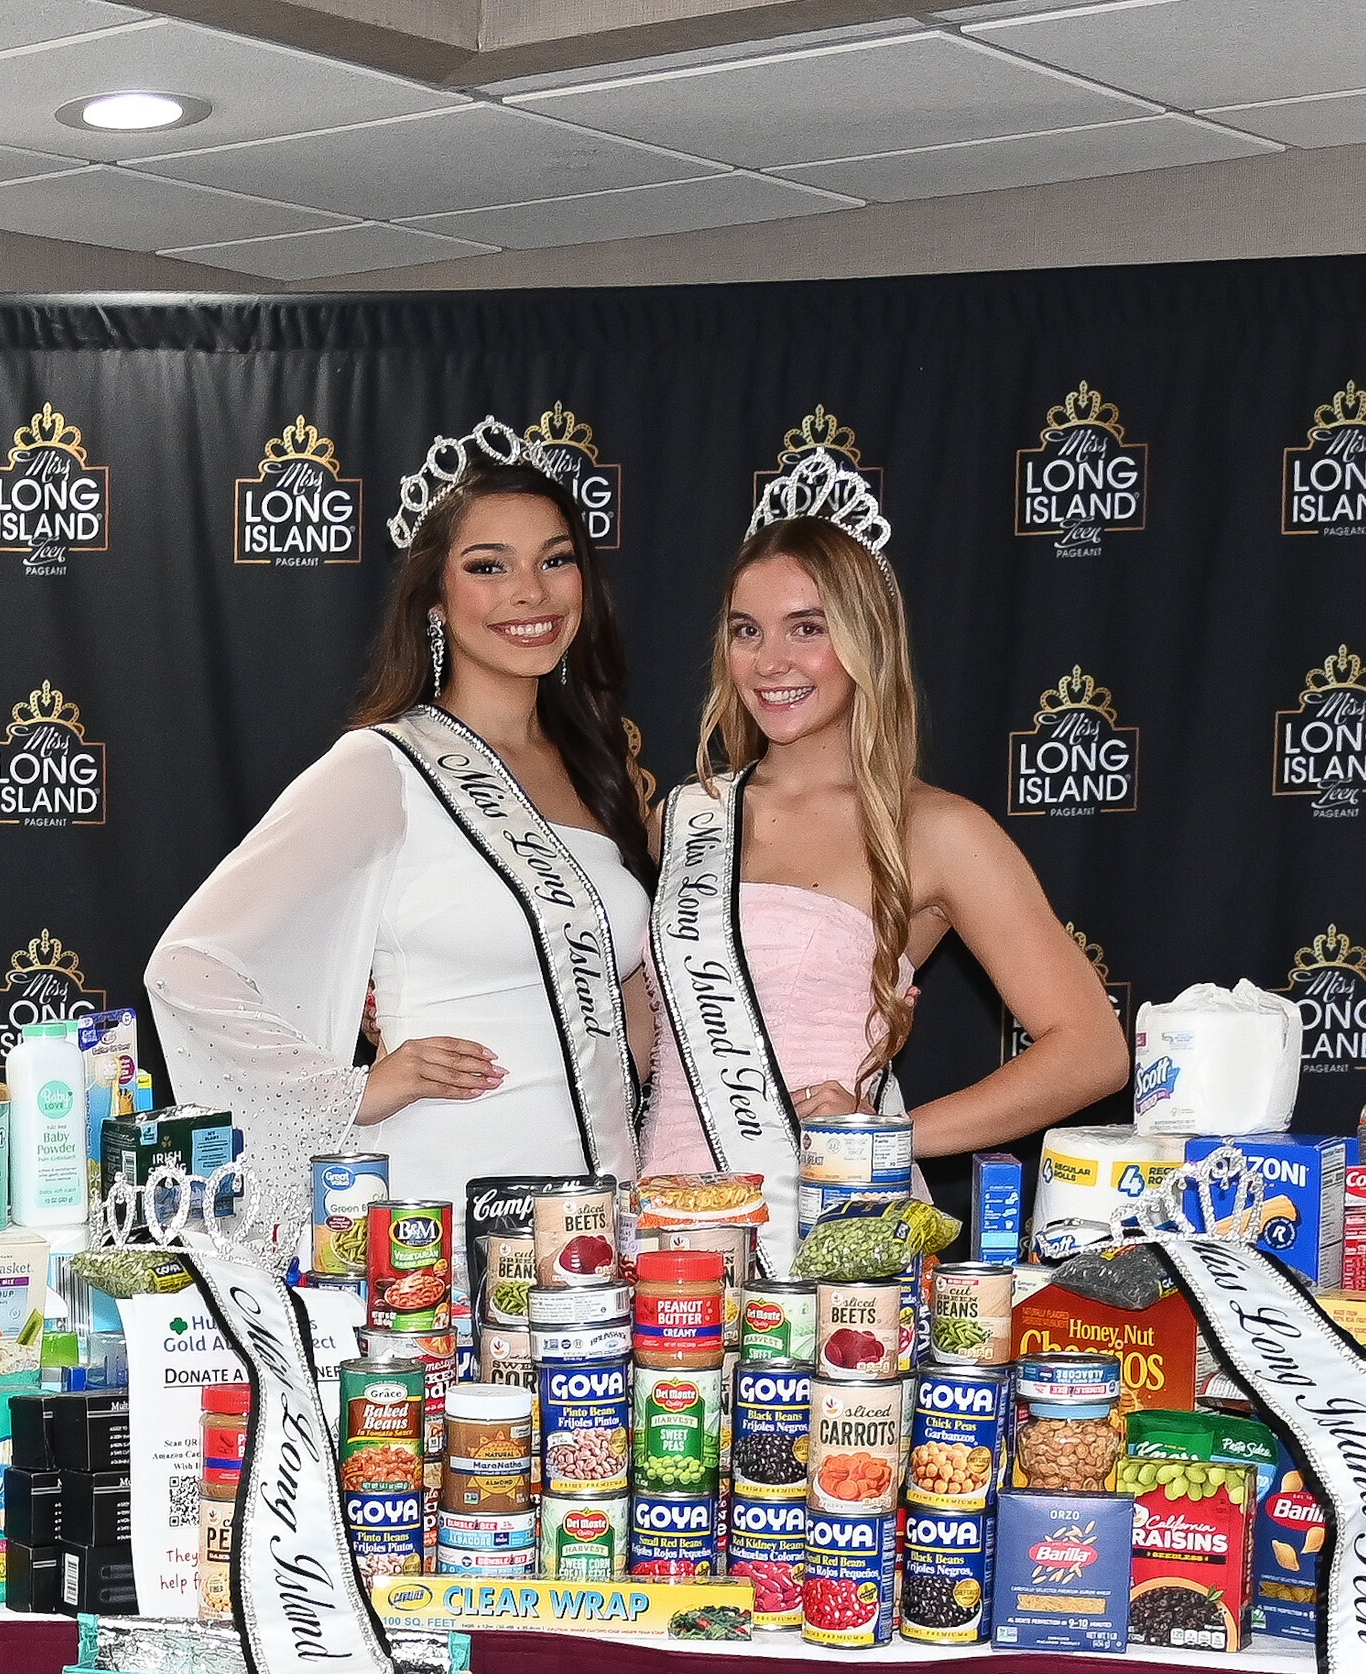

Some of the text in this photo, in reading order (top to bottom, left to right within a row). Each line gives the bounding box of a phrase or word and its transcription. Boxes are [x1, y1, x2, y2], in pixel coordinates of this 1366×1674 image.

[1045, 430, 1108, 459] Miss
[12, 449, 70, 483] Miss
[263, 461, 324, 495] Miss
[1028, 458, 1137, 492] LONG
[245, 491, 352, 522] LONG
[1056, 548, 1102, 557] PAGEANT
[275, 557, 318, 566] PAGEANT
[25, 565, 67, 576] PAGEANT
[1304, 692, 1366, 723] Miss
[1038, 712, 1101, 743] Miss
[10, 725, 70, 757] Miss
[1021, 741, 1129, 773] LONG
[1050, 808, 1095, 817] PAGEANT
[1314, 808, 1359, 818] PAGEANT
[25, 817, 67, 827] PAGEANT
[437, 755, 610, 1039] Miss Long Island
[667, 812, 767, 1141] Miss Long Island Teen
[11, 972, 70, 1001] Miss
[1293, 971, 1355, 1000] Miss
[1303, 1063, 1349, 1073] PAGEANT
[43, 1132, 69, 1144] Baby
[38, 1144, 76, 1154] Powder
[398, 1221, 435, 1240] B&M
[565, 1214, 605, 1231] BEETS
[658, 1301, 703, 1313] PEANUT
[832, 1308, 876, 1323] BEETS
[937, 1302, 978, 1318] BEANS
[658, 1313, 702, 1324] BUTTER
[232, 1286, 295, 1390] Miss
[663, 1329, 697, 1337] CREAMY
[1069, 1320, 1154, 1346] Honey Nut
[164, 1336, 206, 1352] Gold
[1230, 1300, 1317, 1386] Long
[165, 1369, 243, 1384] DONATE A
[551, 1372, 623, 1399] GOYA
[741, 1378, 811, 1401] GOYA
[371, 1390, 402, 1399] Grace
[920, 1383, 993, 1411] GOYA
[364, 1404, 408, 1417] Baked
[563, 1406, 615, 1416] Pinto Beans
[748, 1410, 802, 1420] Black Beans
[845, 1405, 891, 1418] sliced
[364, 1417, 408, 1429] Beans
[558, 1416, 592, 1429] Frijoles
[654, 1417, 694, 1426] HARVEST
[660, 1430, 688, 1441] SWEET
[820, 1420, 895, 1446] CARROTS
[663, 1441, 684, 1451] PEAS
[261, 1392, 320, 1533] Long
[348, 1500, 418, 1519] GOYA
[637, 1504, 708, 1529] GOYA
[734, 1506, 804, 1530] GOYA
[1051, 1510, 1079, 1520] ORZO
[907, 1518, 979, 1544] GOYA
[1145, 1516, 1216, 1531] California
[807, 1520, 875, 1546] GOYA
[1133, 1529, 1228, 1552] RAISINS
[1036, 1548, 1092, 1562] Barilla
[270, 1536, 353, 1661] Island
[443, 1586, 538, 1617] CLEAR
[550, 1590, 650, 1620] WRAP
[385, 1617, 456, 1627] 100 SQ. FEET
